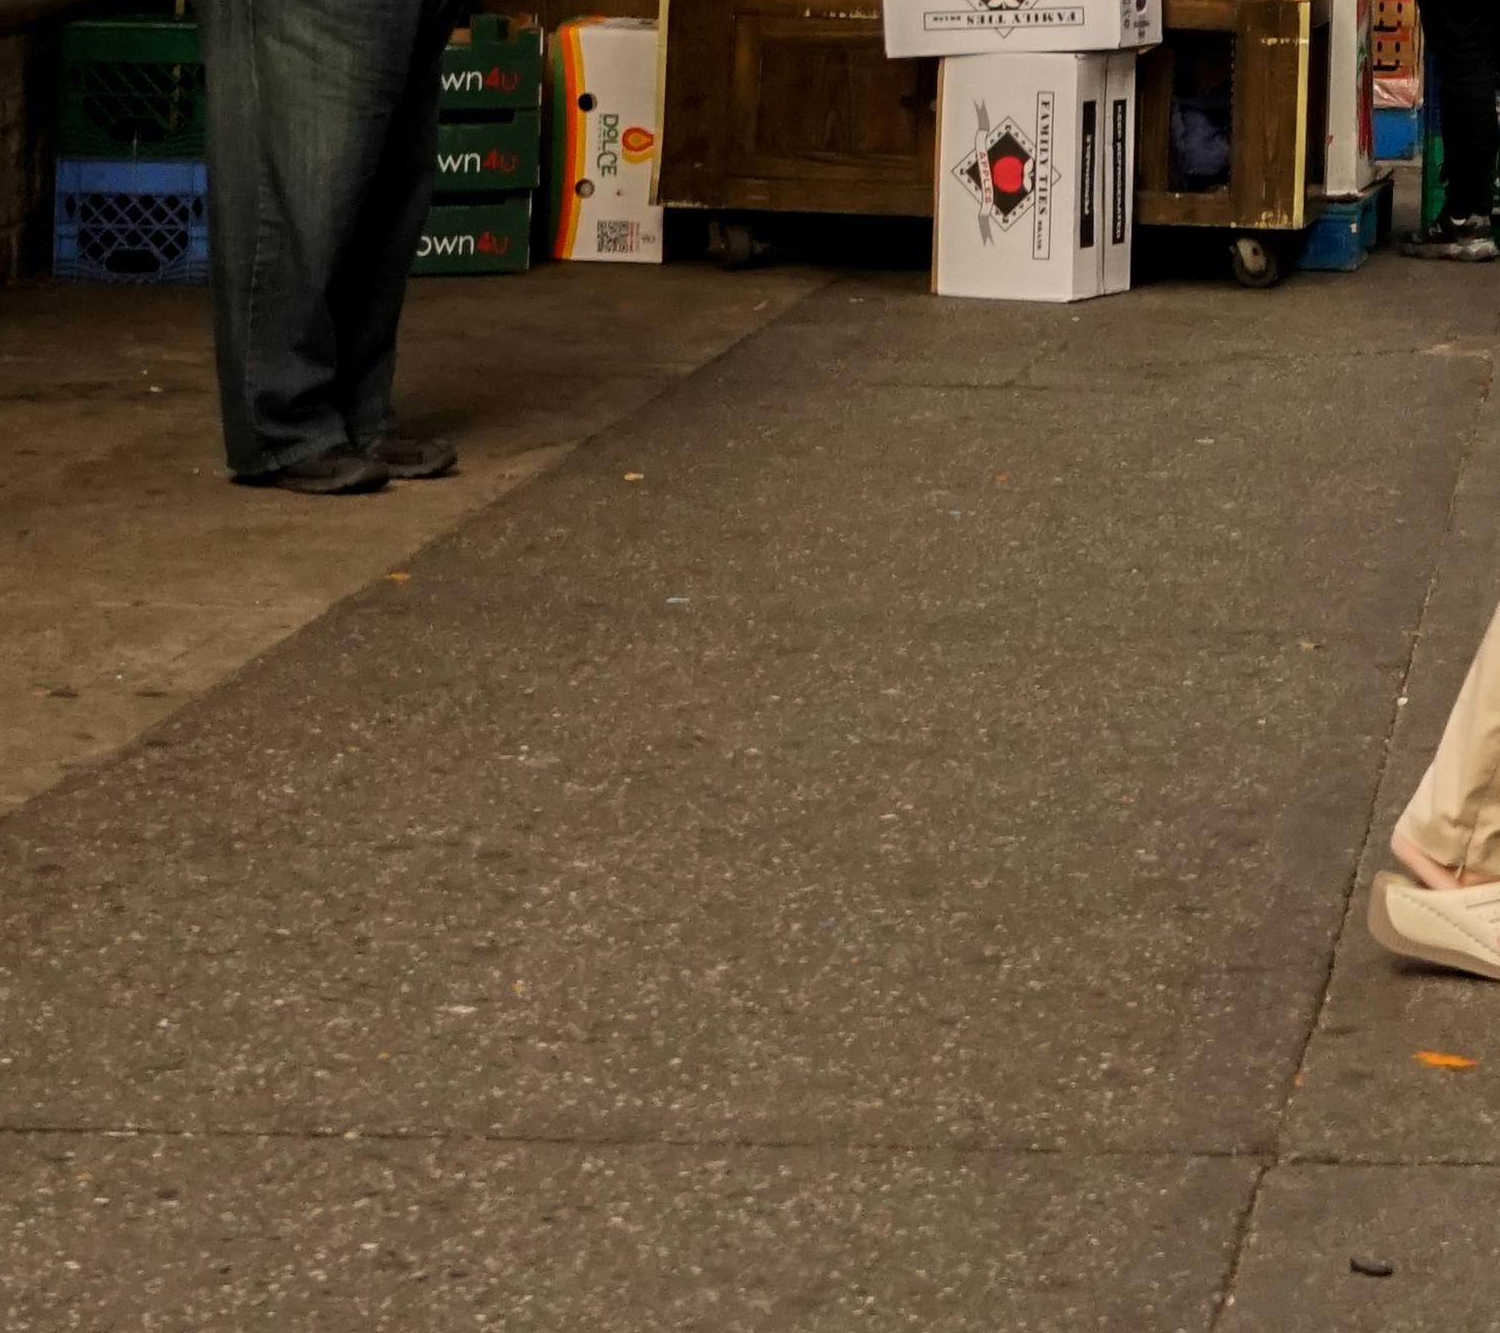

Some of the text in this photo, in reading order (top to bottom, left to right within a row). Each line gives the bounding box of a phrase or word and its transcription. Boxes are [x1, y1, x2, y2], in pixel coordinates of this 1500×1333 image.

[966, 13, 1006, 25] TIES
[1012, 12, 1077, 24] FAMILY
[597, 113, 619, 178] DOLCE
[1039, 100, 1051, 165] FAMILY
[978, 151, 992, 204] APPLES
[1038, 175, 1049, 215] TIES
